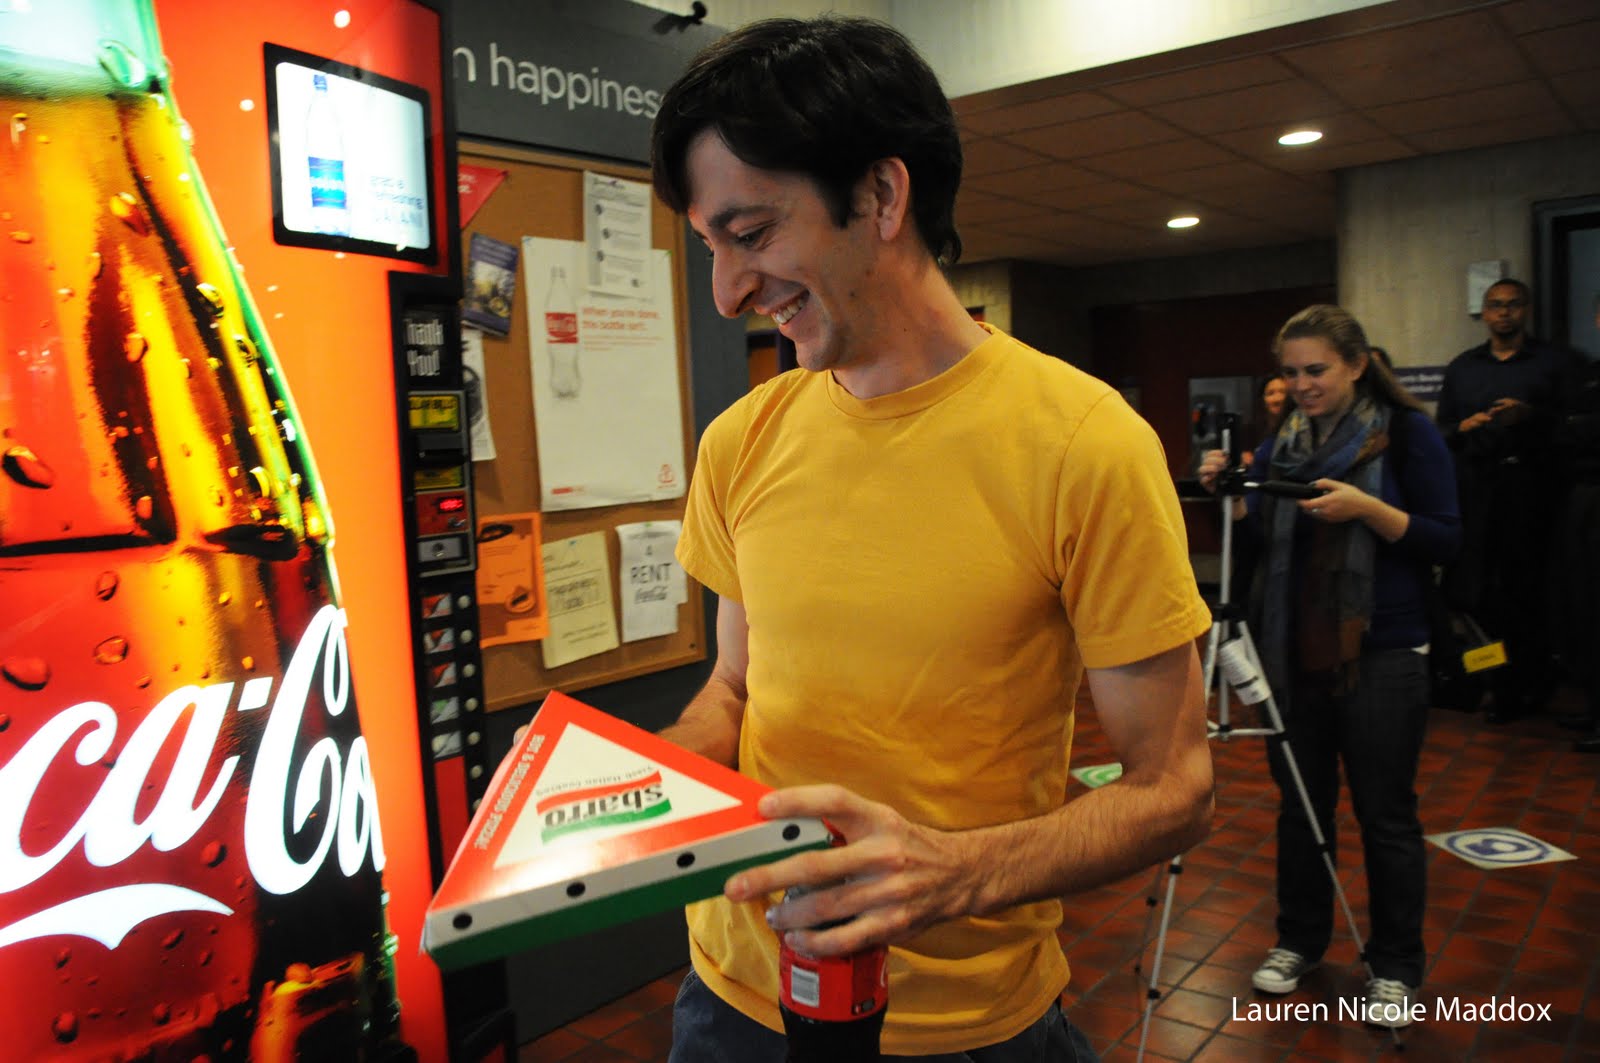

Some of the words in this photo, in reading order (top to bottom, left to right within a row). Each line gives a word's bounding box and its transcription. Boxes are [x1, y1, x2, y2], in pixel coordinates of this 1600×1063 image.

[490, 42, 664, 119] happines
[403, 318, 445, 346] Thank
[630, 562, 673, 586] RENT
[544, 783, 664, 828] sbarro
